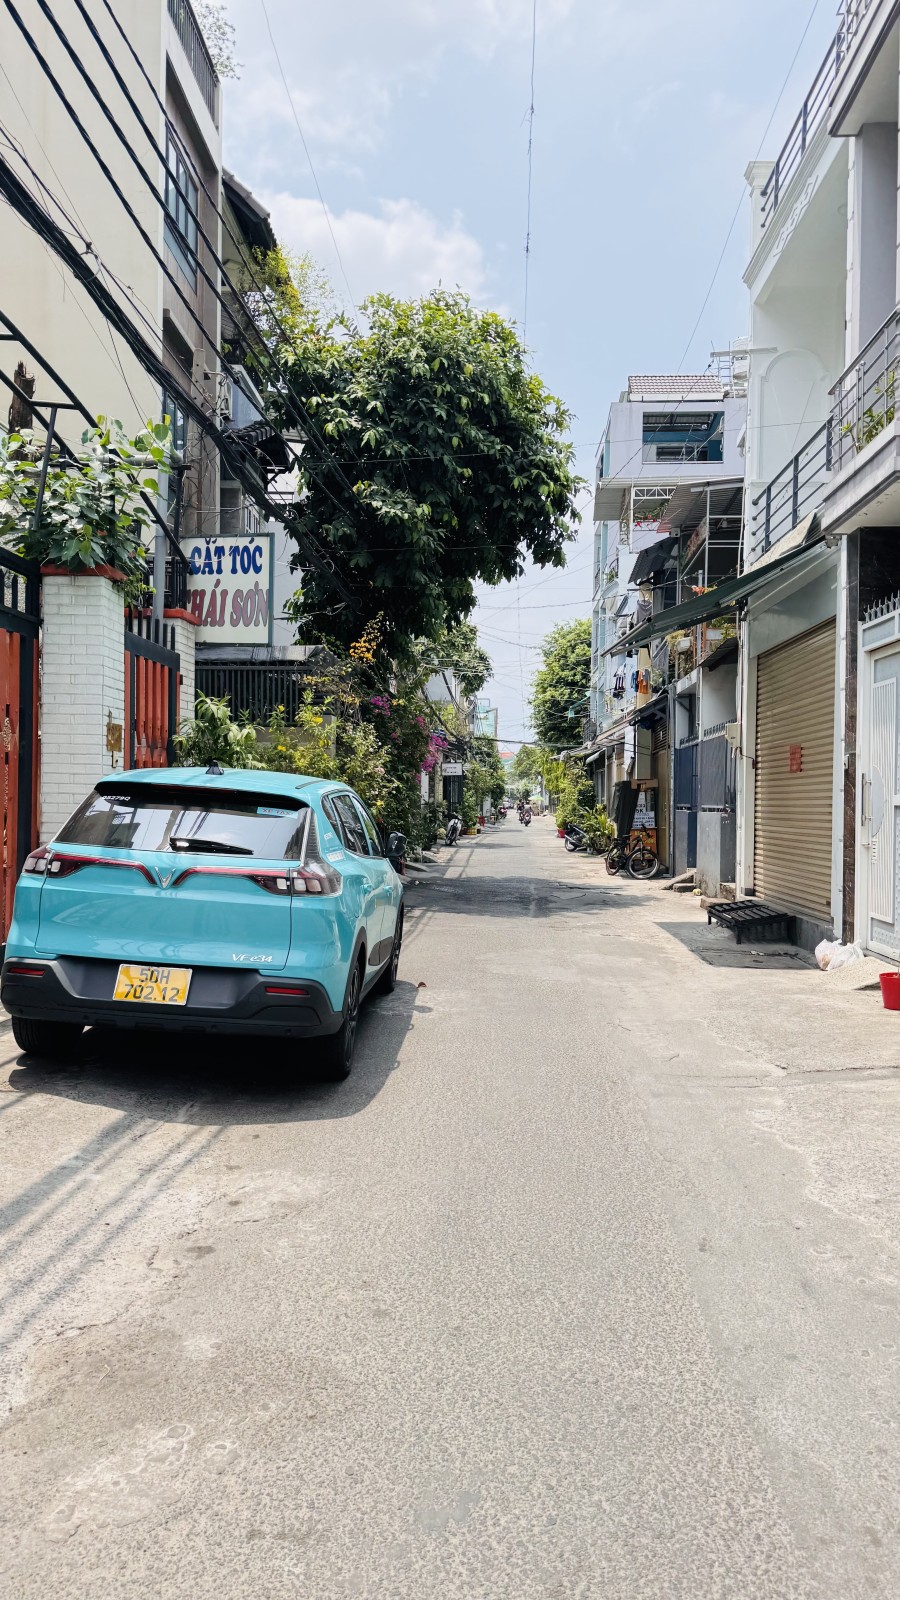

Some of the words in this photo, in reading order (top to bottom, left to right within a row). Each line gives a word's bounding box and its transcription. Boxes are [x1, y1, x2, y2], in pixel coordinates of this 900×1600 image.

[190, 537, 225, 575] CẮT
[229, 537, 263, 575] TÓC
[230, 581, 269, 627] SƠN
[232, 953, 249, 961] VF
[249, 955, 273, 963] e34
[138, 968, 171, 984] 50H
[123, 984, 180, 1002] 702.12
